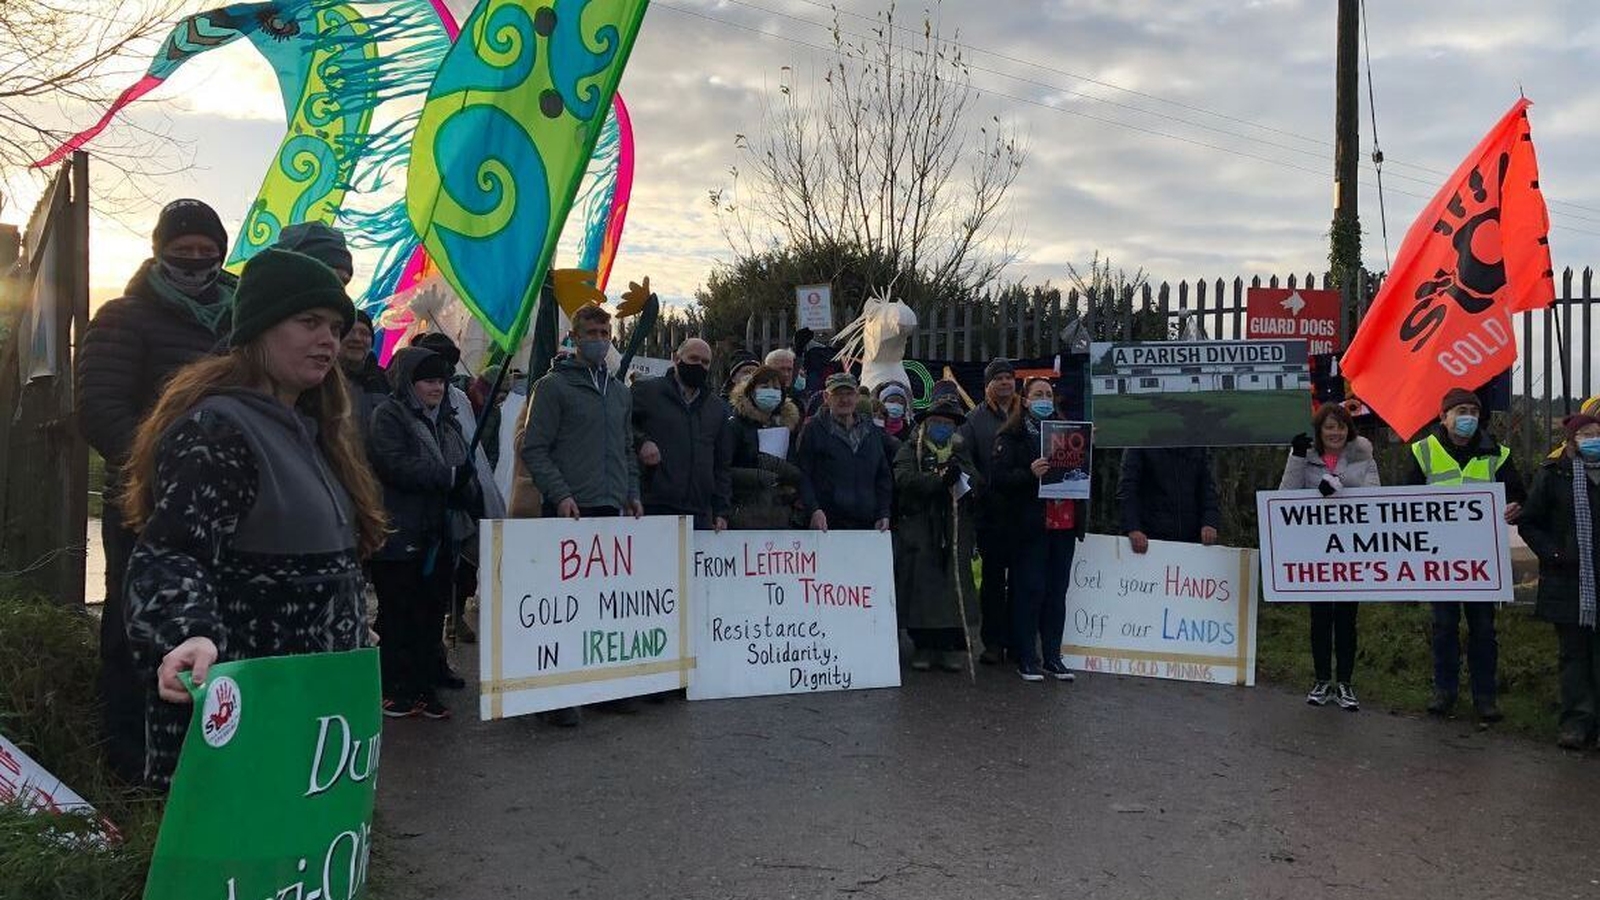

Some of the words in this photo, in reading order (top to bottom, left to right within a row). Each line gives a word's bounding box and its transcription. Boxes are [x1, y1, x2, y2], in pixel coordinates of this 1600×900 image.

[1250, 317, 1295, 334] GUARD
[1300, 319, 1334, 336] DOGS
[1115, 349, 1128, 364] A
[1133, 347, 1200, 364] PARISH
[1207, 346, 1284, 362] DIVIDED
[1438, 316, 1509, 376] GOLD
[1051, 432, 1084, 451] NO
[1280, 503, 1368, 526] WHERE
[1376, 500, 1484, 524] THERE'S
[1325, 533, 1345, 553] A
[1353, 531, 1439, 555] MINE,
[560, 534, 633, 582] BAN
[694, 551, 736, 577] FROM
[1283, 560, 1389, 583] THERE'S
[1397, 561, 1416, 582] A
[1424, 559, 1491, 582] RISK
[763, 583, 784, 606] TO
[799, 578, 873, 609] TYRONE
[1117, 576, 1160, 597] your
[1165, 566, 1230, 601] HANDS
[520, 594, 579, 628] GOLD
[599, 588, 675, 620] MINING
[712, 615, 826, 642] Resistance,
[1074, 607, 1109, 639] Off
[1121, 621, 1152, 638] our
[1162, 607, 1235, 645] LANDS
[537, 643, 559, 671] IN
[582, 628, 668, 666] IRELAND
[747, 643, 839, 665] Solidarity,
[1085, 656, 1101, 671] NO
[1128, 658, 1159, 675] GOLD
[789, 667, 852, 691] Dignity
